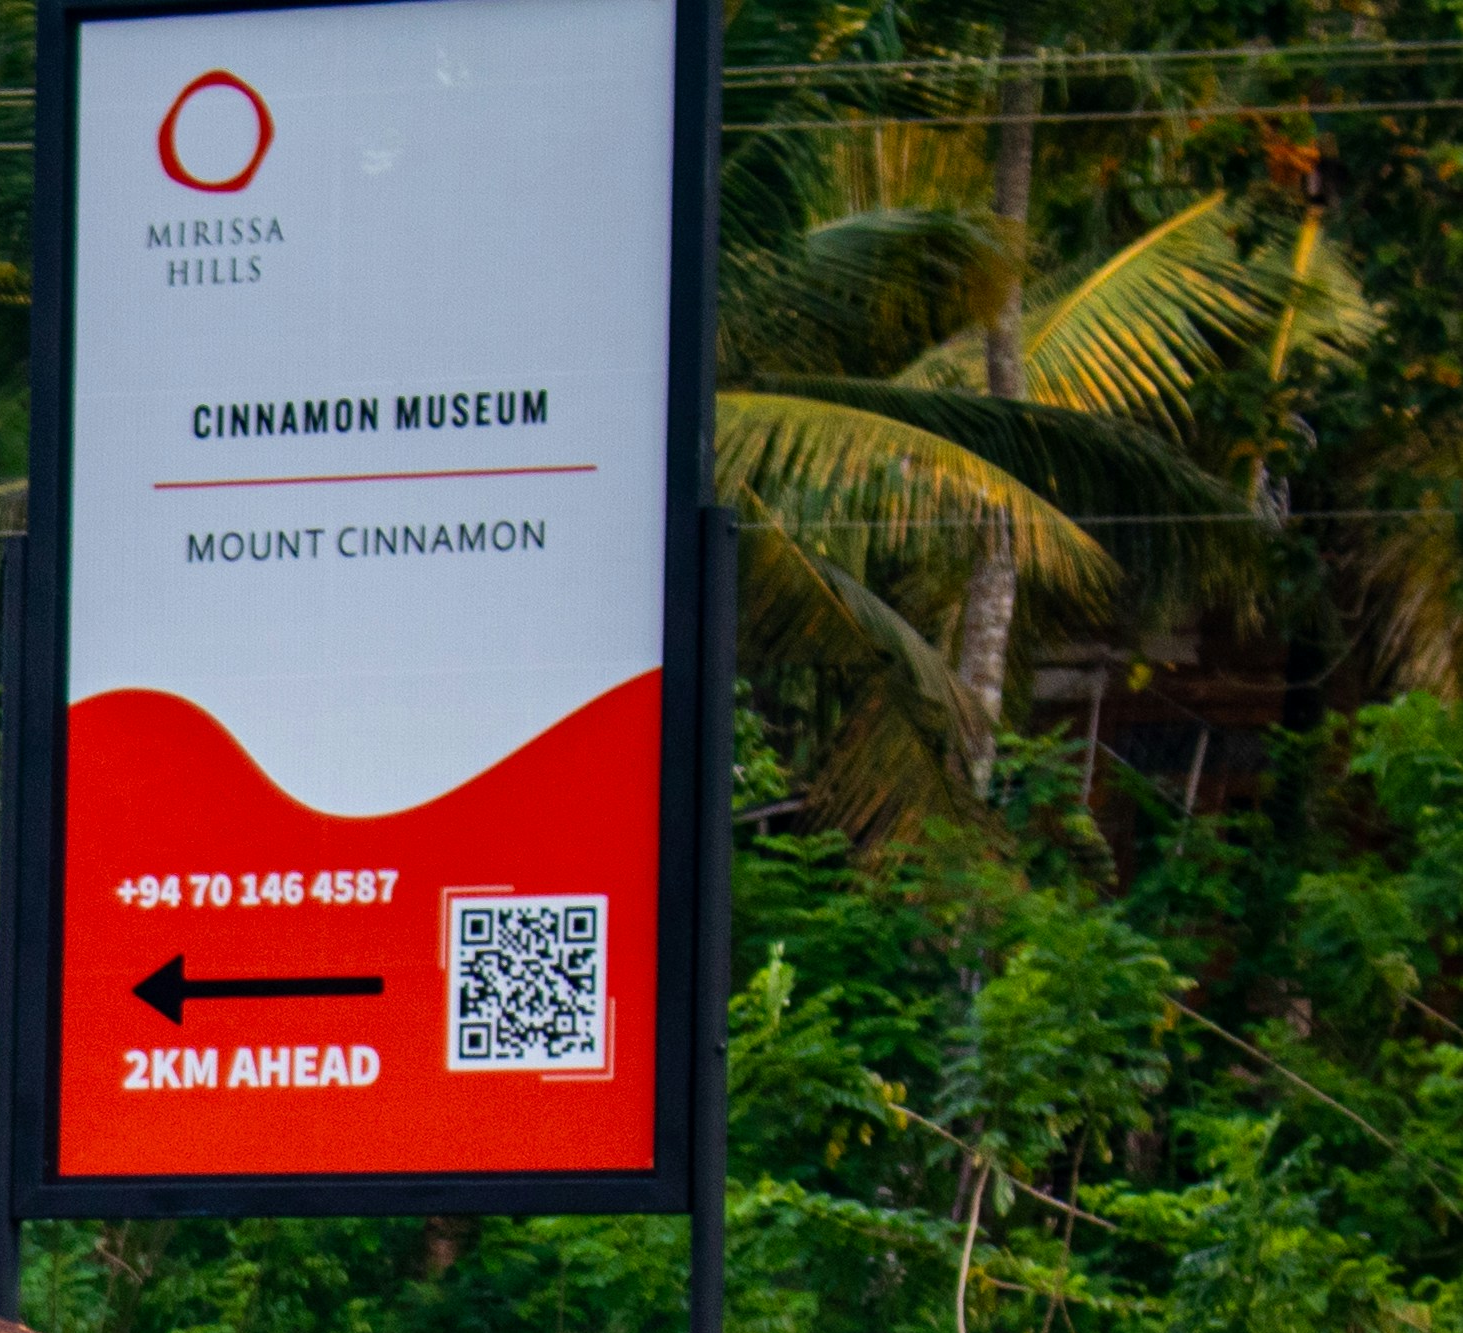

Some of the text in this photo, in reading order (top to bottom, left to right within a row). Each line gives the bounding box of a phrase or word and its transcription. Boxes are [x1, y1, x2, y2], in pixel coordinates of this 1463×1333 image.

[146, 217, 285, 249] MIRISSA
[167, 256, 263, 287] HILLS
[193, 389, 548, 439] CINNAMON MUSEUM
[188, 520, 546, 563] MOUNT CINNAMON
[116, 870, 399, 908] +94 70 146 4587
[123, 1045, 380, 1089] 2KM AHEAD
